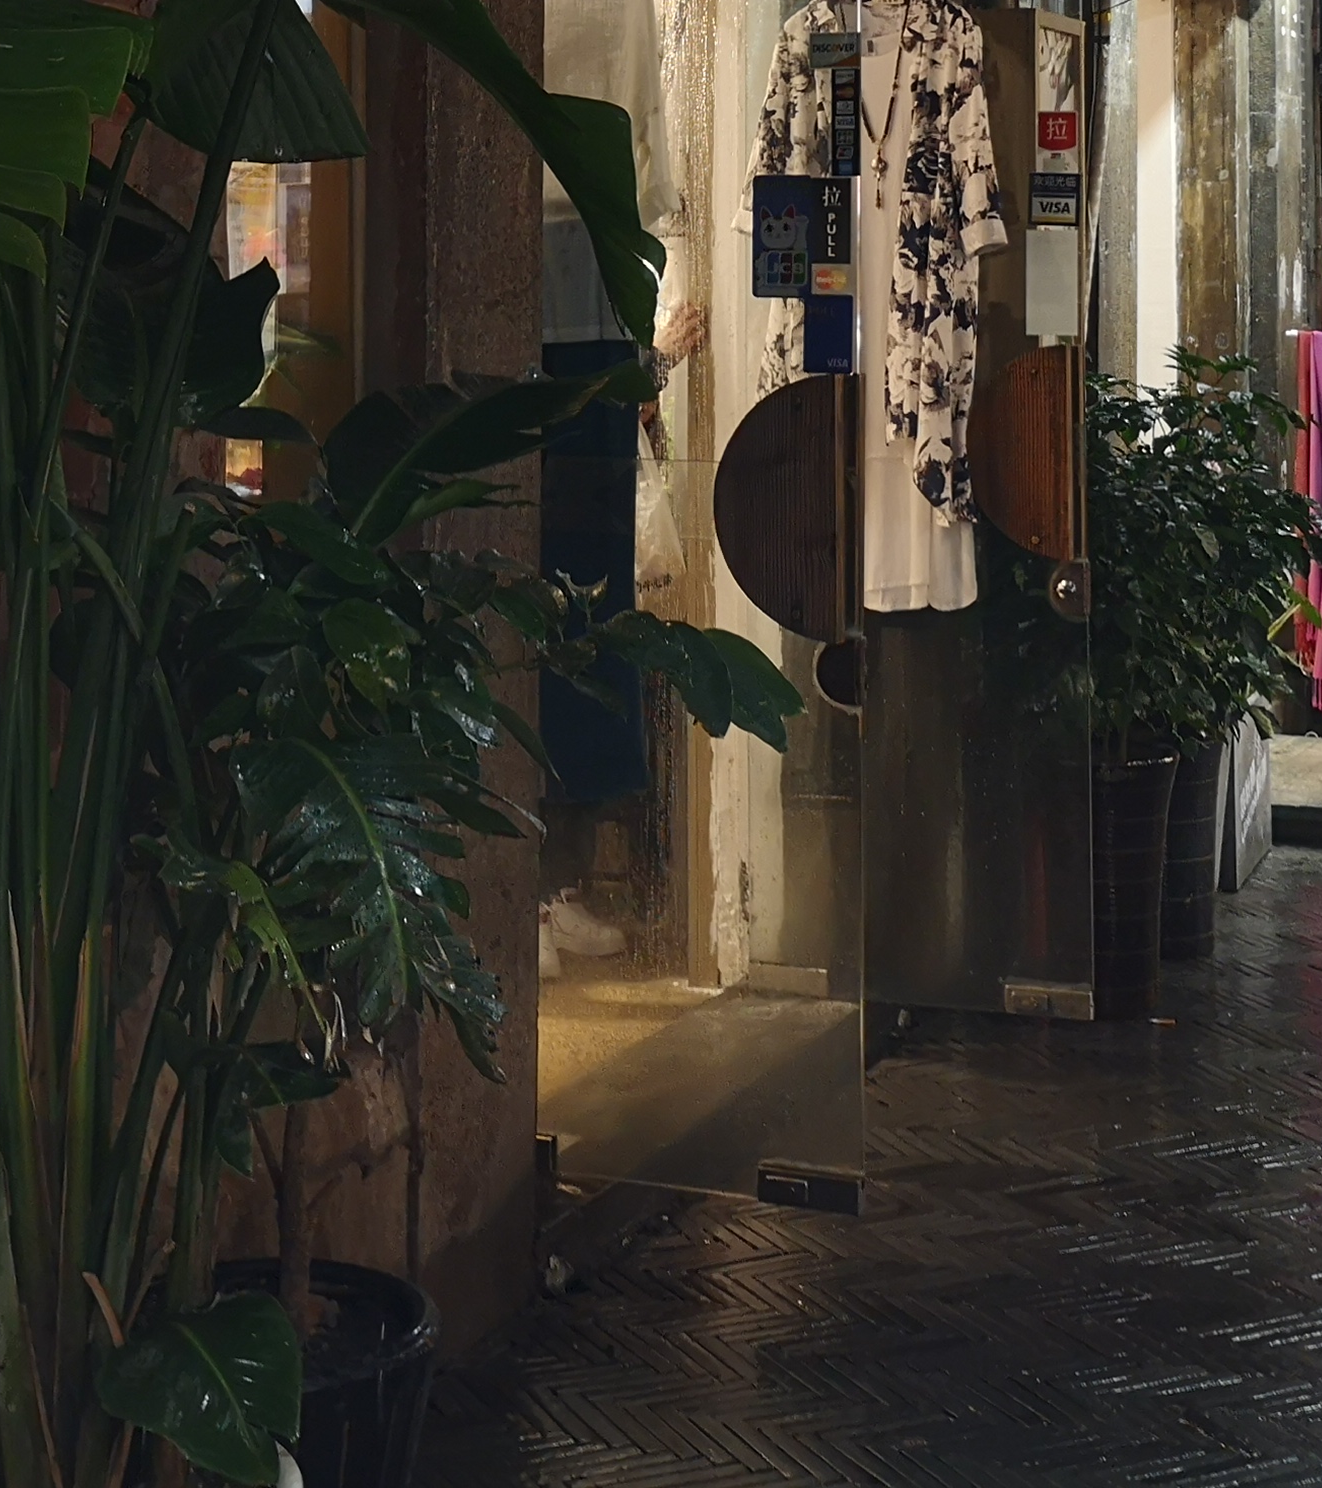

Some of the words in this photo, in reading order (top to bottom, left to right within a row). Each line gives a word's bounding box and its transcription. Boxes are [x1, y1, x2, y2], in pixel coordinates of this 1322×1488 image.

[812, 41, 855, 54] DISCOVER
[1046, 116, 1068, 141] 拉
[822, 185, 842, 207] 拉
[1038, 200, 1071, 214] VISA
[826, 212, 837, 258] PULL
[826, 357, 849, 369] VISA
